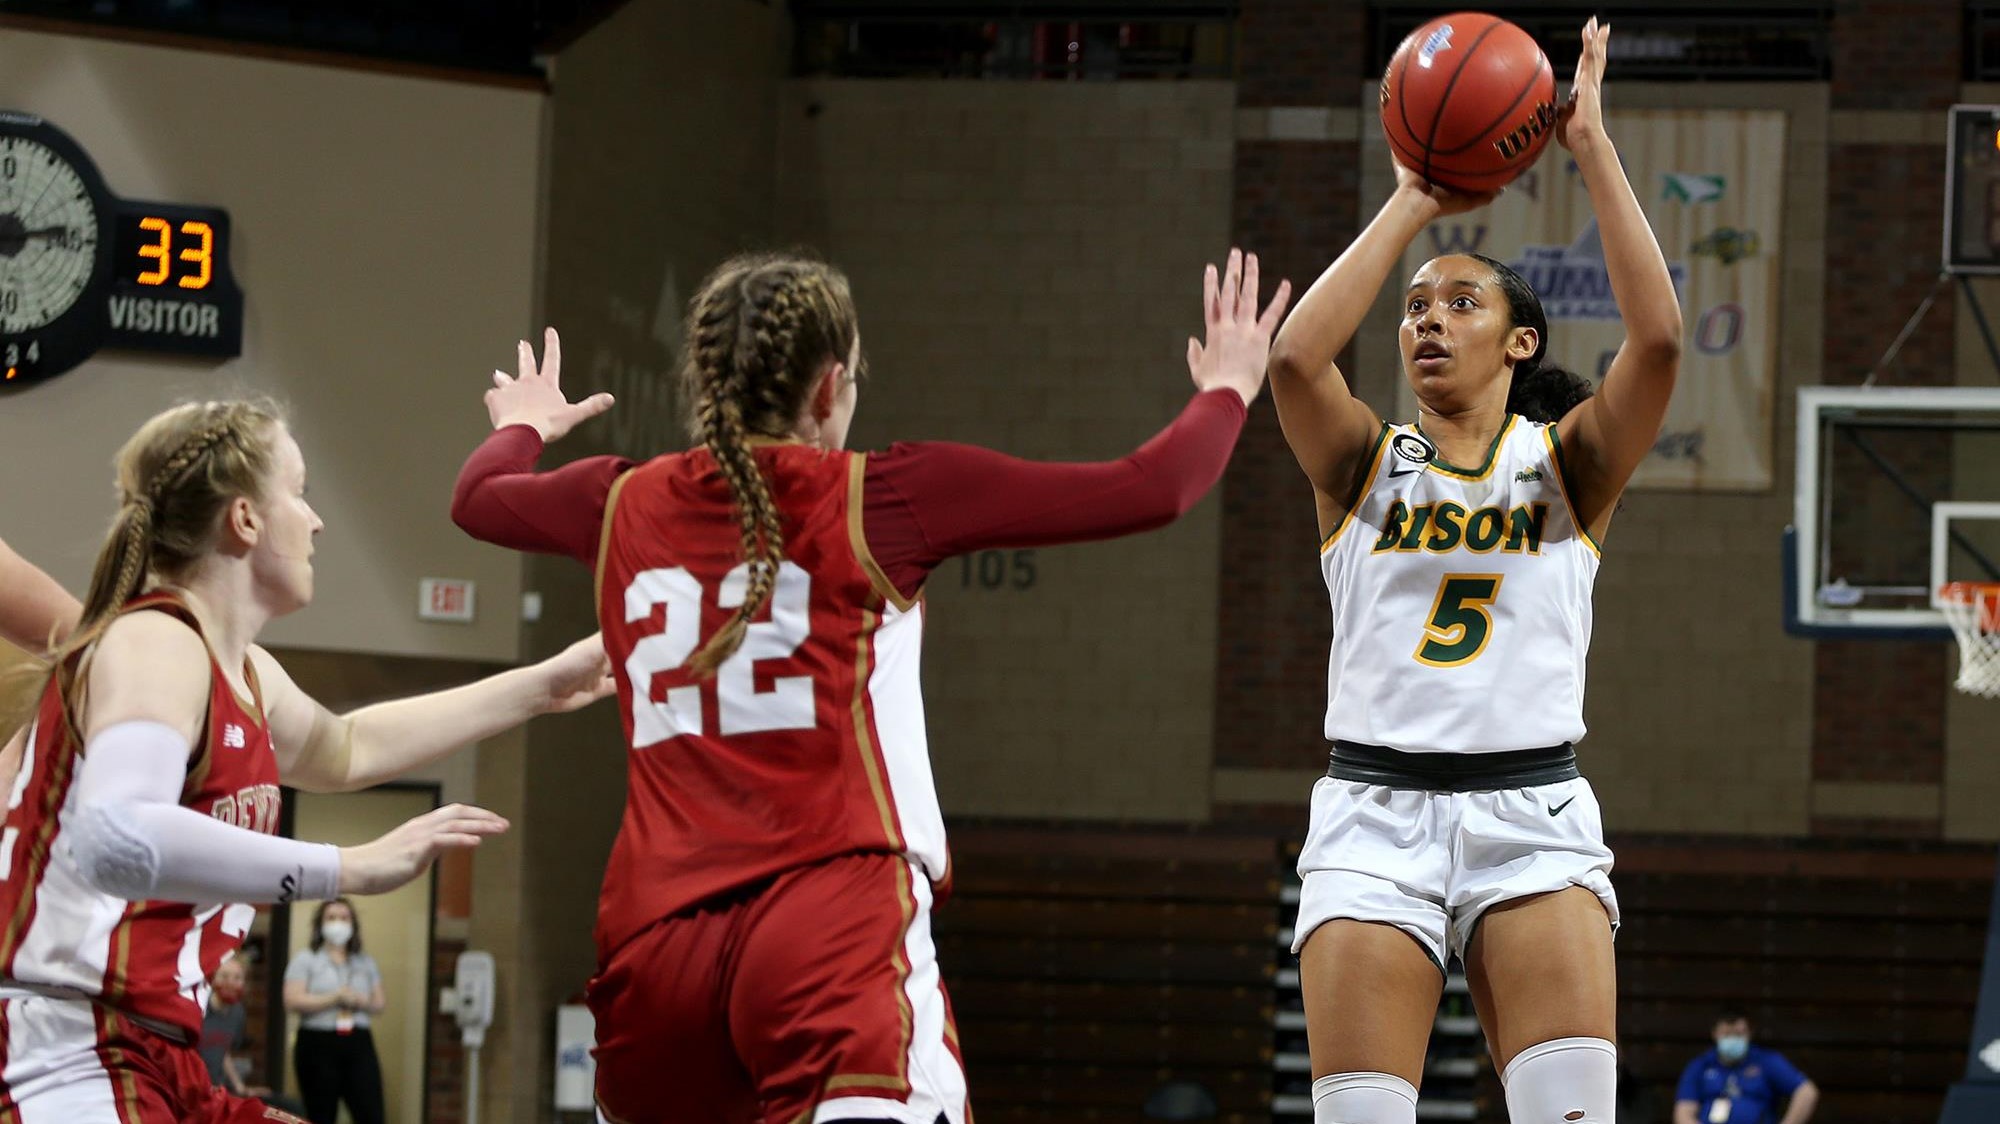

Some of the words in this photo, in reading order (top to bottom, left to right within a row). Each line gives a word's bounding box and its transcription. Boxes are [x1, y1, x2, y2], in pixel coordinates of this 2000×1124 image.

[136, 216, 214, 290] 33
[108, 295, 220, 338] VISITOR
[1370, 497, 1551, 557] BISON
[961, 549, 1038, 592] 105
[624, 560, 817, 748] 22
[1412, 573, 1505, 668] 5
